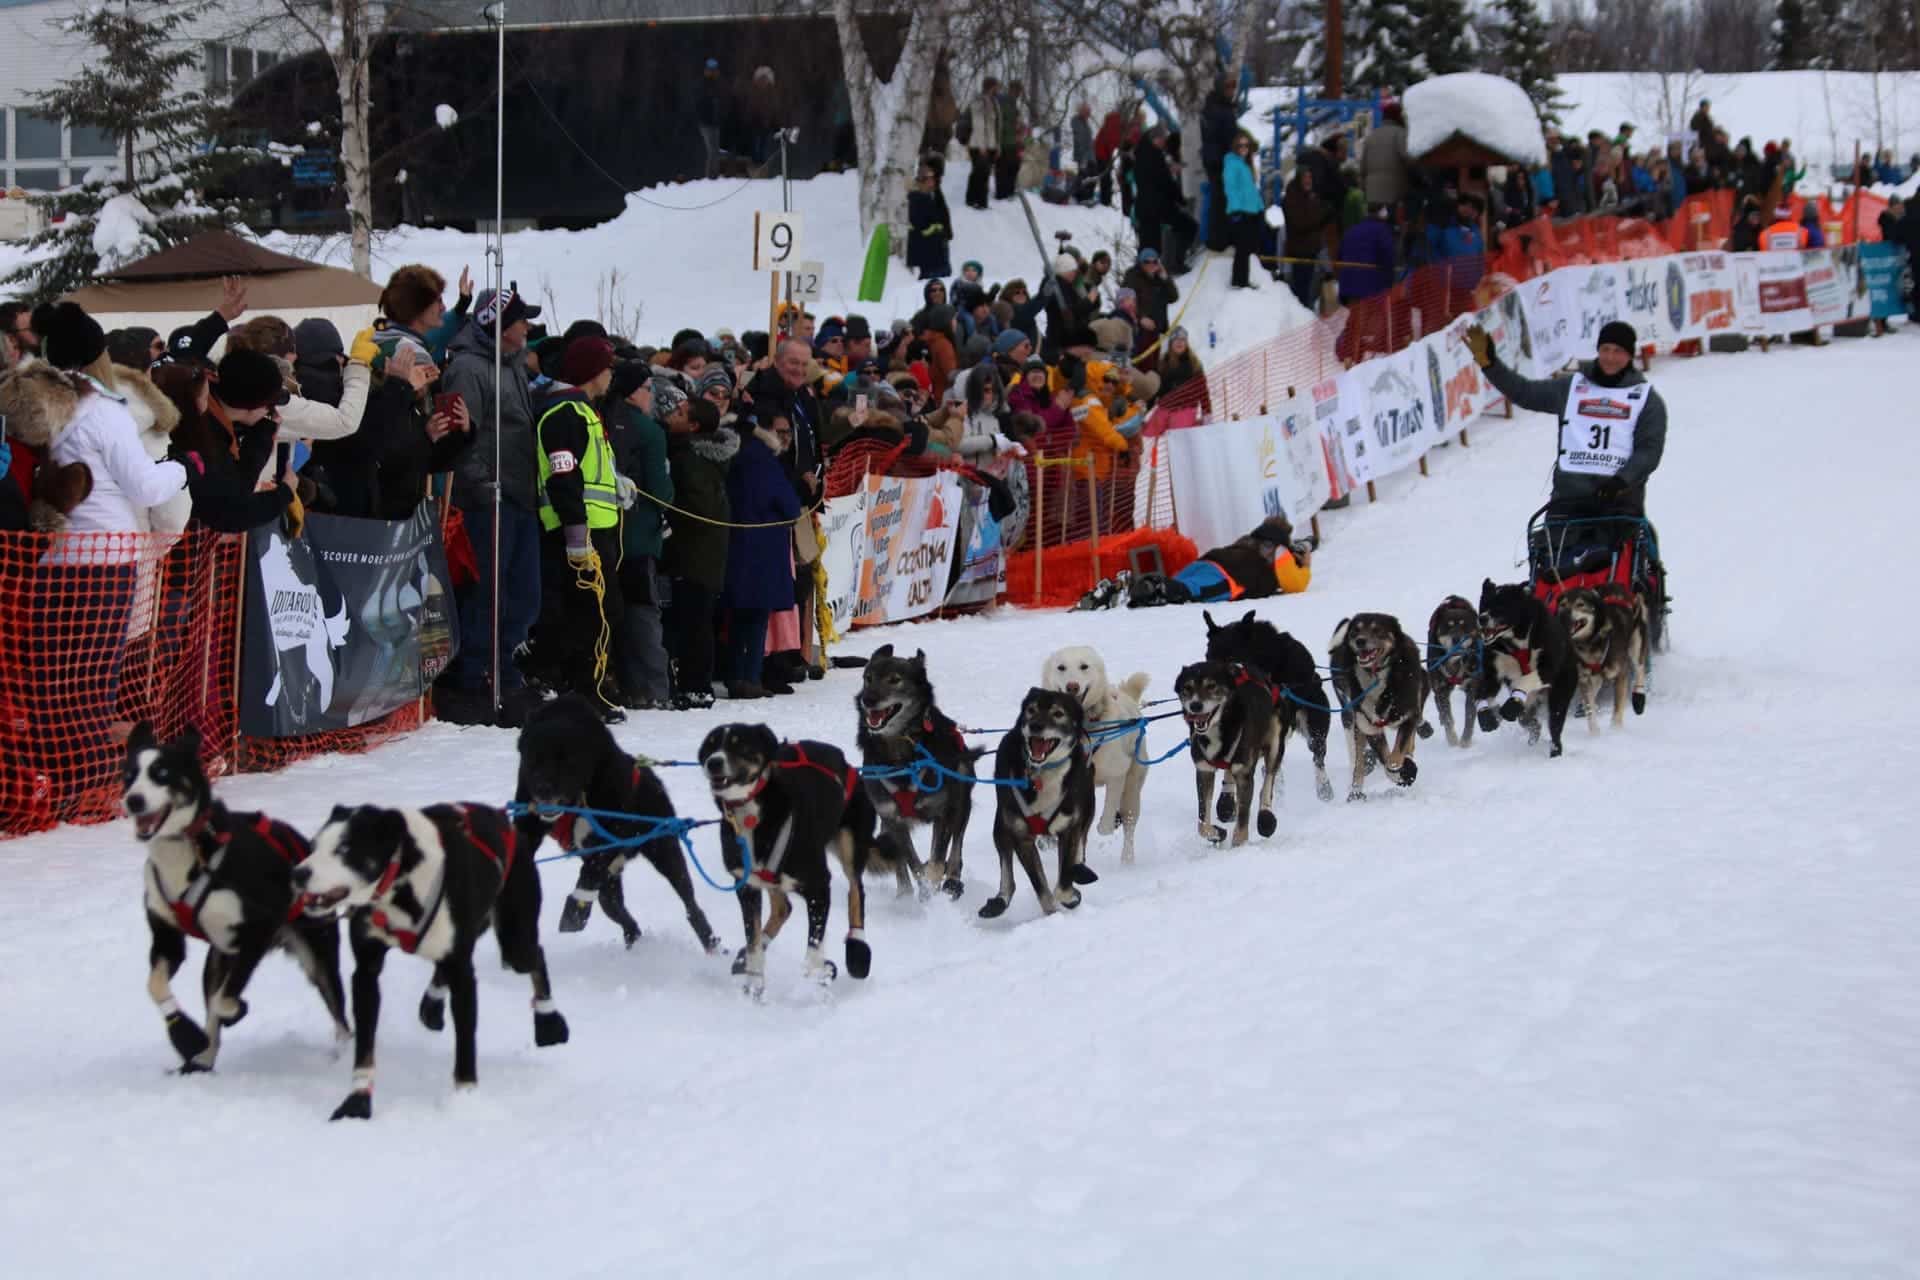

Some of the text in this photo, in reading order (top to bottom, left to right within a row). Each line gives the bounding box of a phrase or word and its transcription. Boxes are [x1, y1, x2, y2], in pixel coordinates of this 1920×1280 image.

[770, 222, 792, 262] 9
[794, 273, 817, 294] 12
[1588, 423, 1611, 450] 31
[321, 550, 359, 564] SCOVER
[360, 553, 384, 565] MORE
